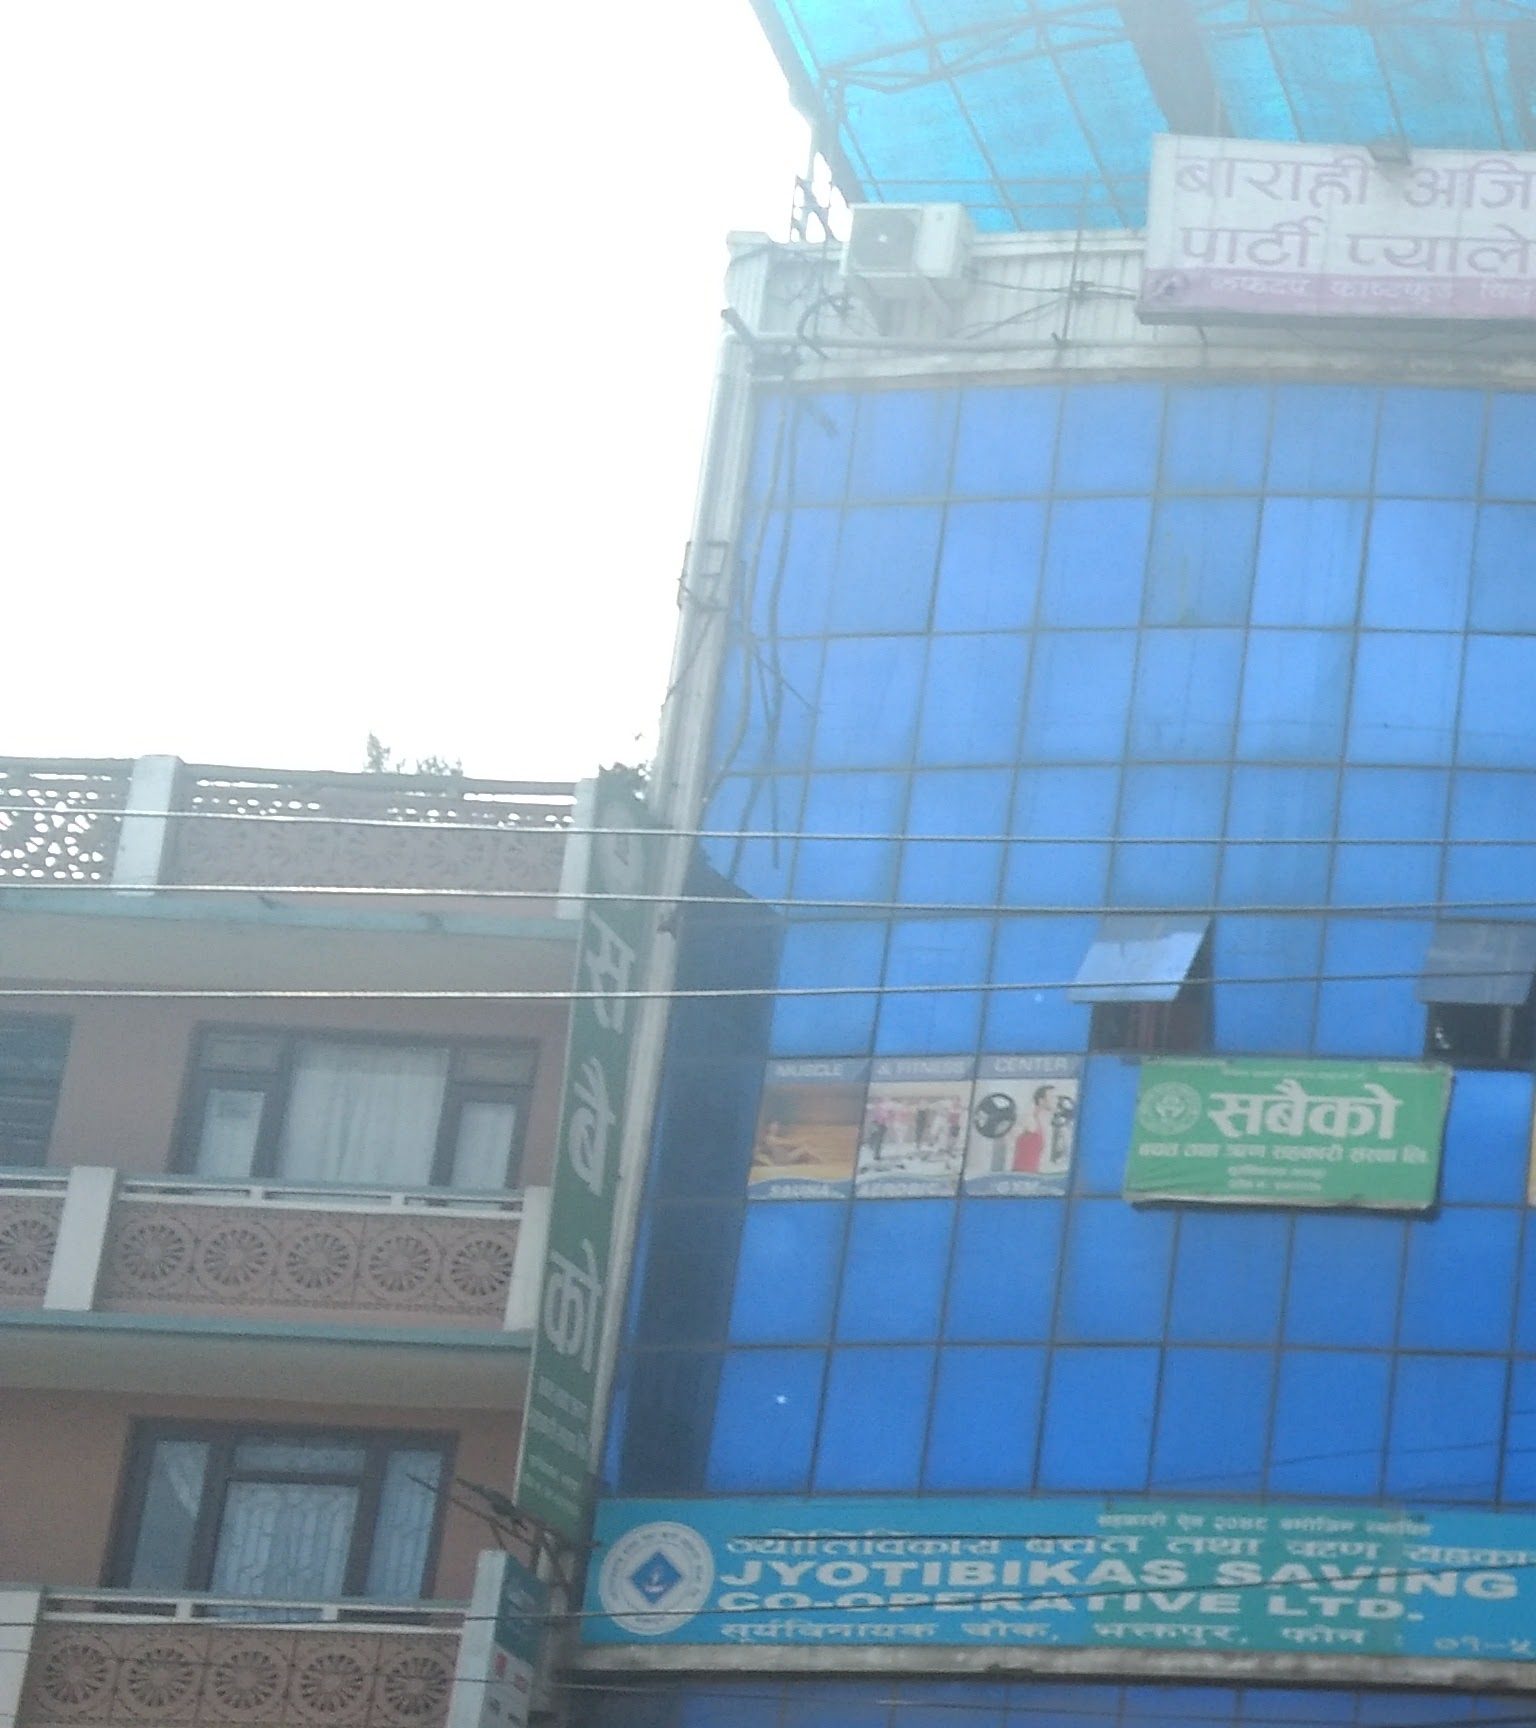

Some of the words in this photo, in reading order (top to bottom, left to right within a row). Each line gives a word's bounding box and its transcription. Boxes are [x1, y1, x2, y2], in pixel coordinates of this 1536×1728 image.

[1182, 216, 1323, 267] पार्टी
[994, 1057, 1068, 1073] CENTER
[1207, 1078, 1404, 1140] सबैको
[1166, 1536, 1263, 1557] तथा
[720, 1560, 1189, 1586] JYOTIBIKAS
[1214, 1560, 1518, 1599] SAVING
[718, 1590, 1242, 1616] CO-OPERATIVE
[1266, 1595, 1425, 1621] LTD.
